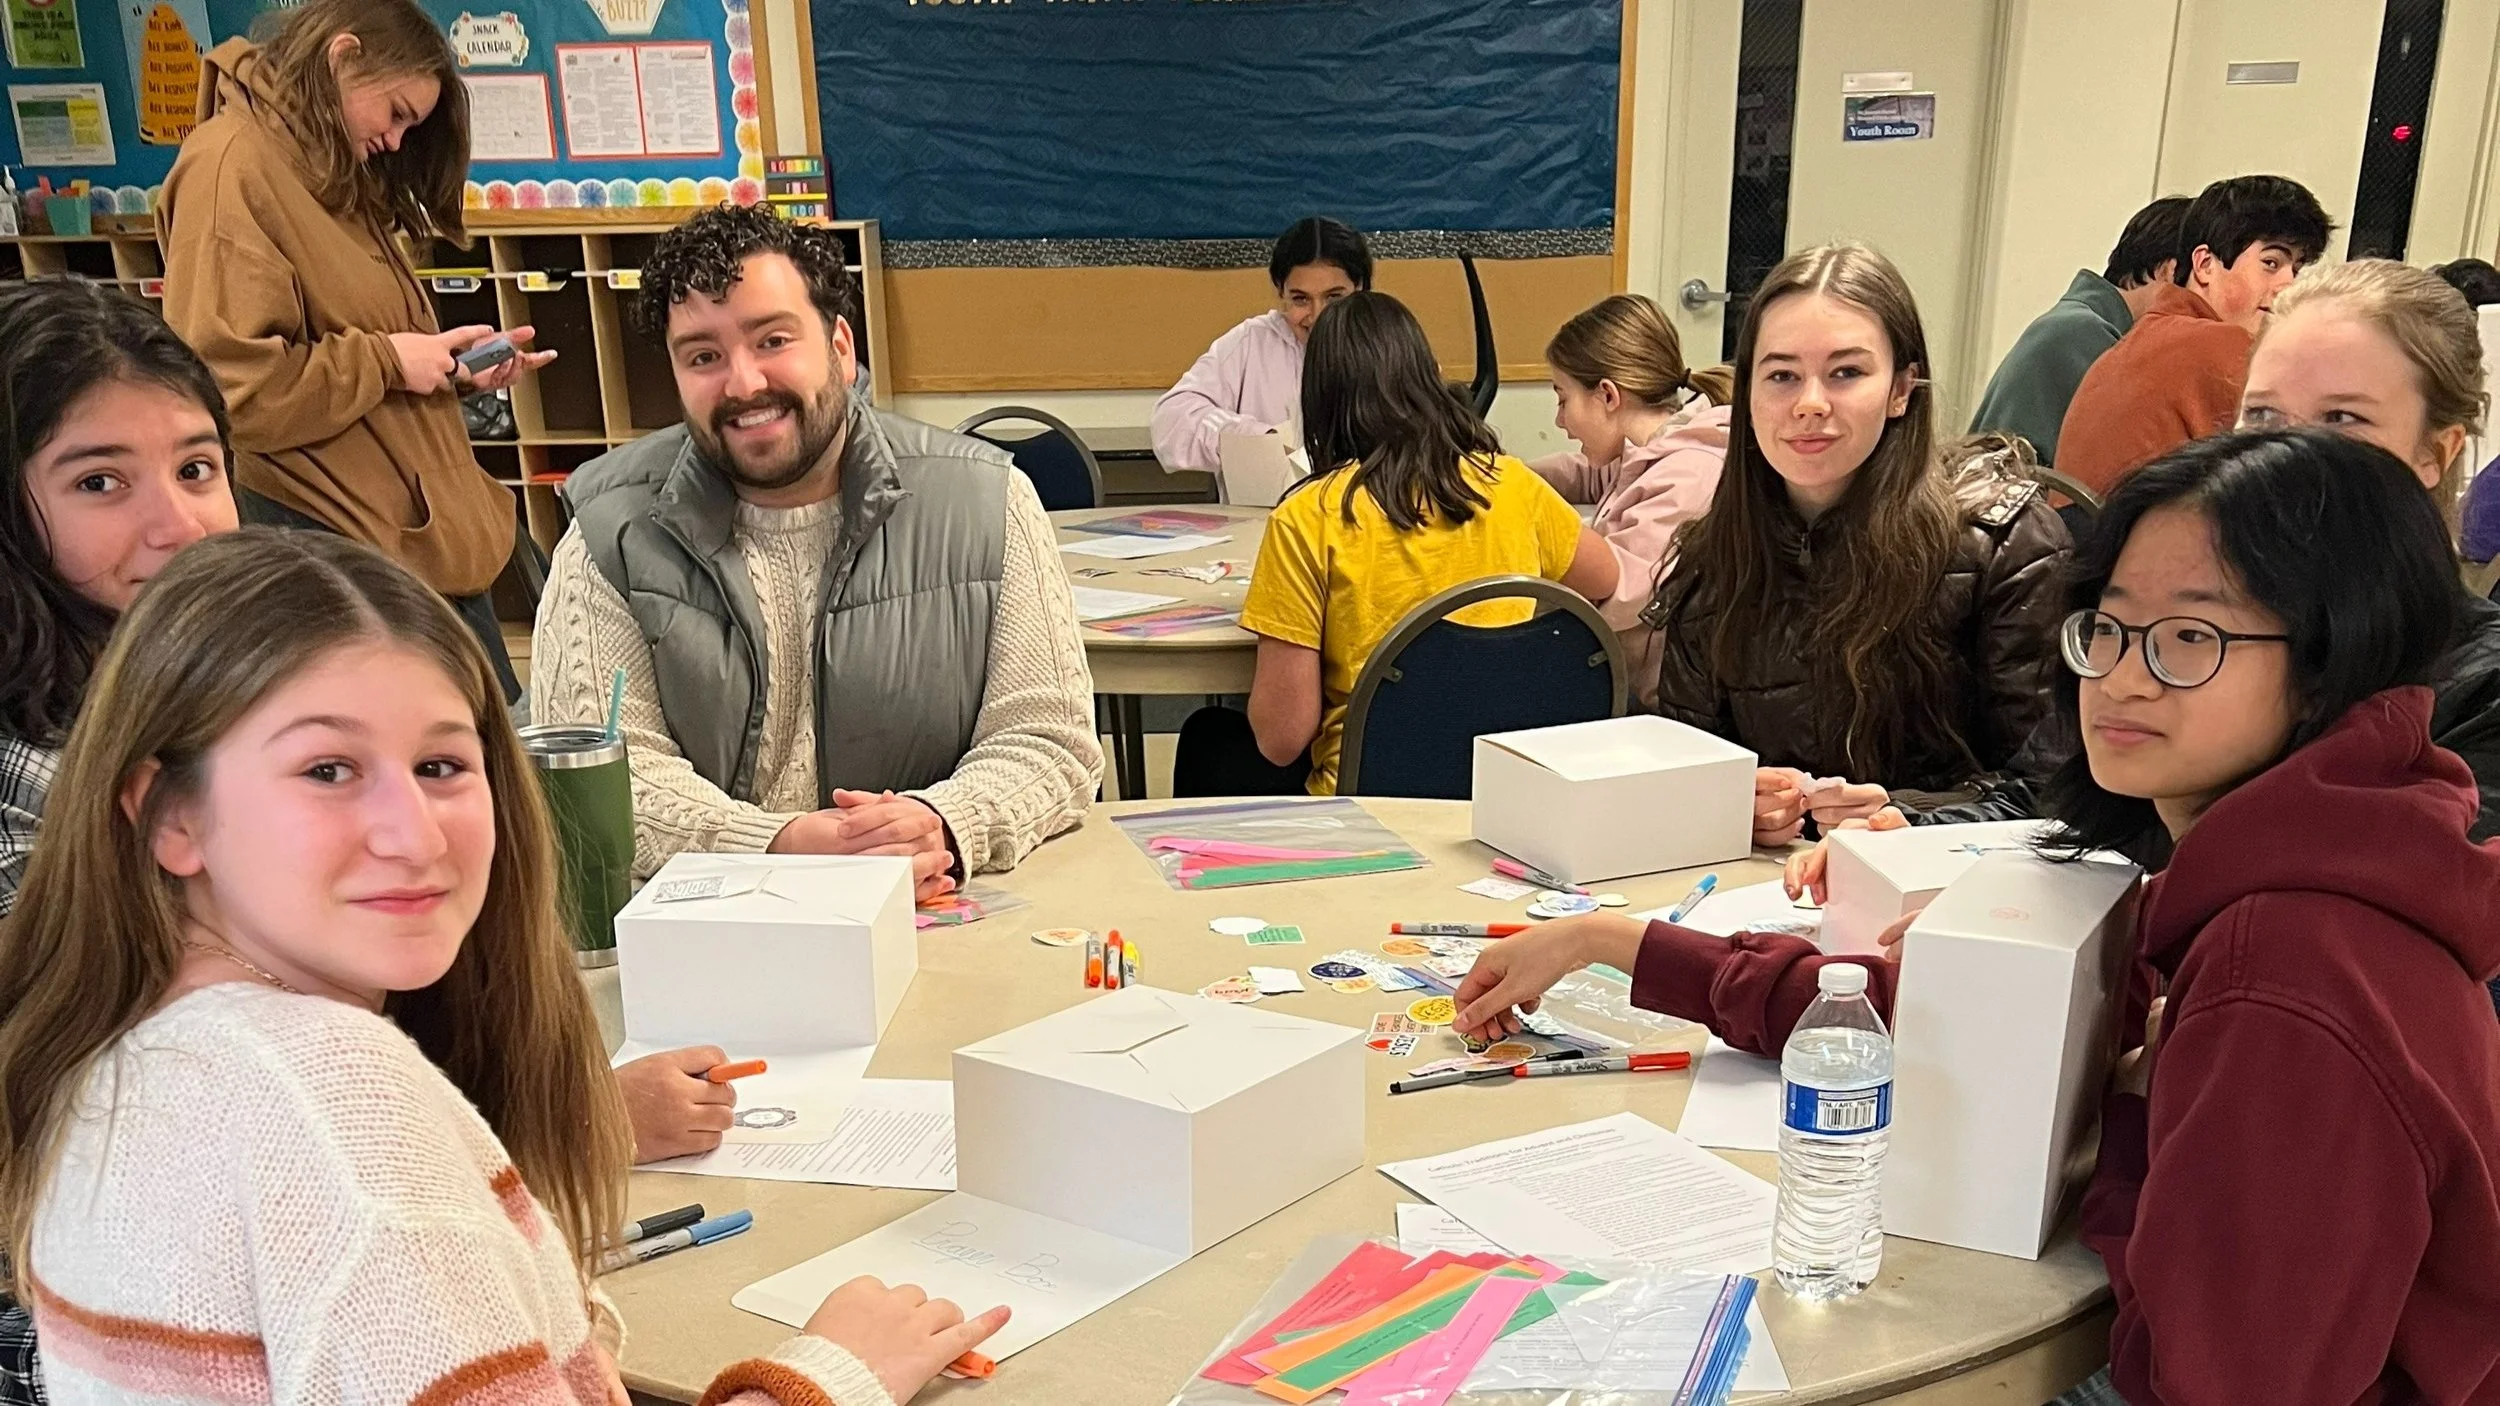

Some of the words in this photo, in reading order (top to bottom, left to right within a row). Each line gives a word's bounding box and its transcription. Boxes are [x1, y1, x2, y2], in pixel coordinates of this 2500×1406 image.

[472, 24, 500, 36] SNACK
[466, 40, 513, 55] CALENDAR
[1849, 126, 1882, 137] Youth
[1884, 125, 1916, 136] Room
[1465, 1151, 1509, 1165] Traditions
